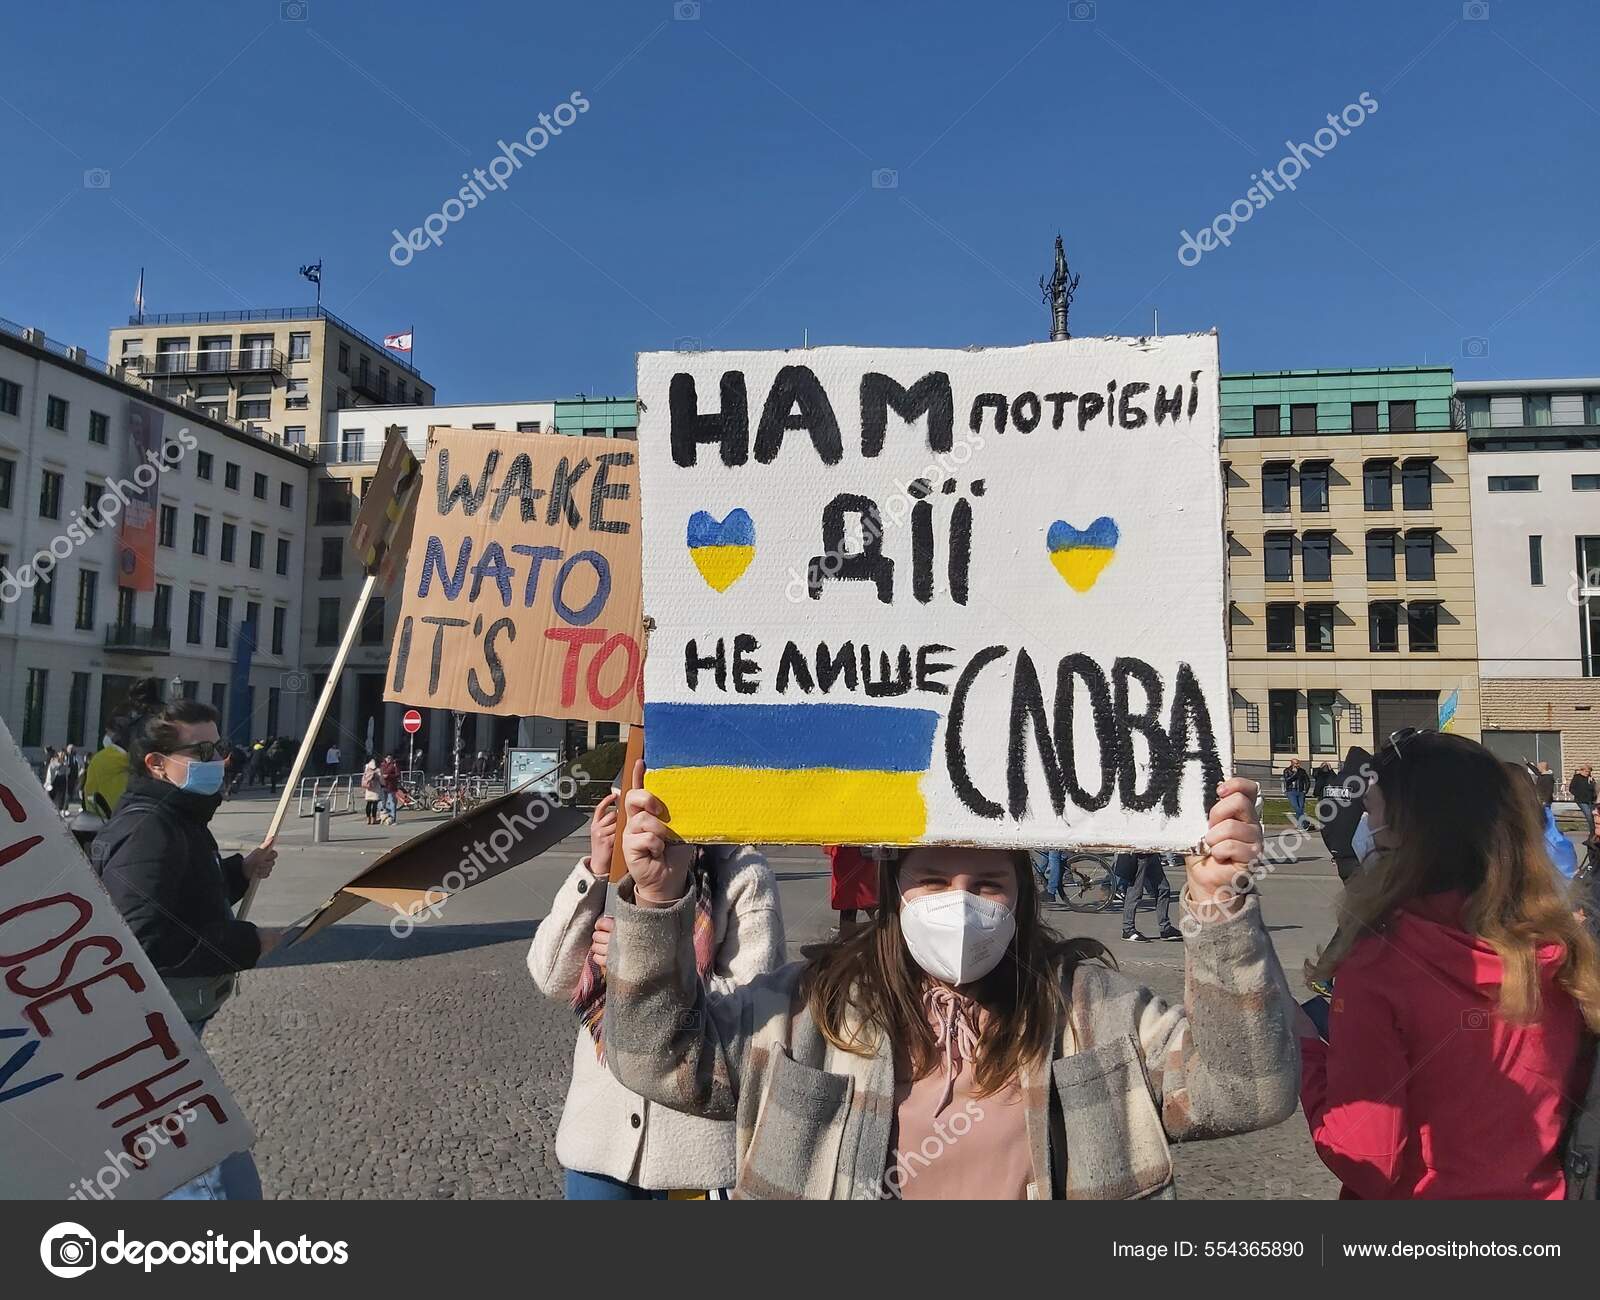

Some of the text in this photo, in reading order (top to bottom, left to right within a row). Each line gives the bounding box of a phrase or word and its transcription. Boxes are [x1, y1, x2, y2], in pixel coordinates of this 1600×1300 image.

[670, 365, 955, 467] НАМ
[436, 448, 635, 535] WAKE
[417, 536, 612, 626] NATO
[393, 613, 517, 708] IT'S
[685, 634, 1226, 826] НЕ ЛИШЕ СЛОВА
[0, 783, 147, 1037] OSE
[75, 1011, 229, 1170] THE
